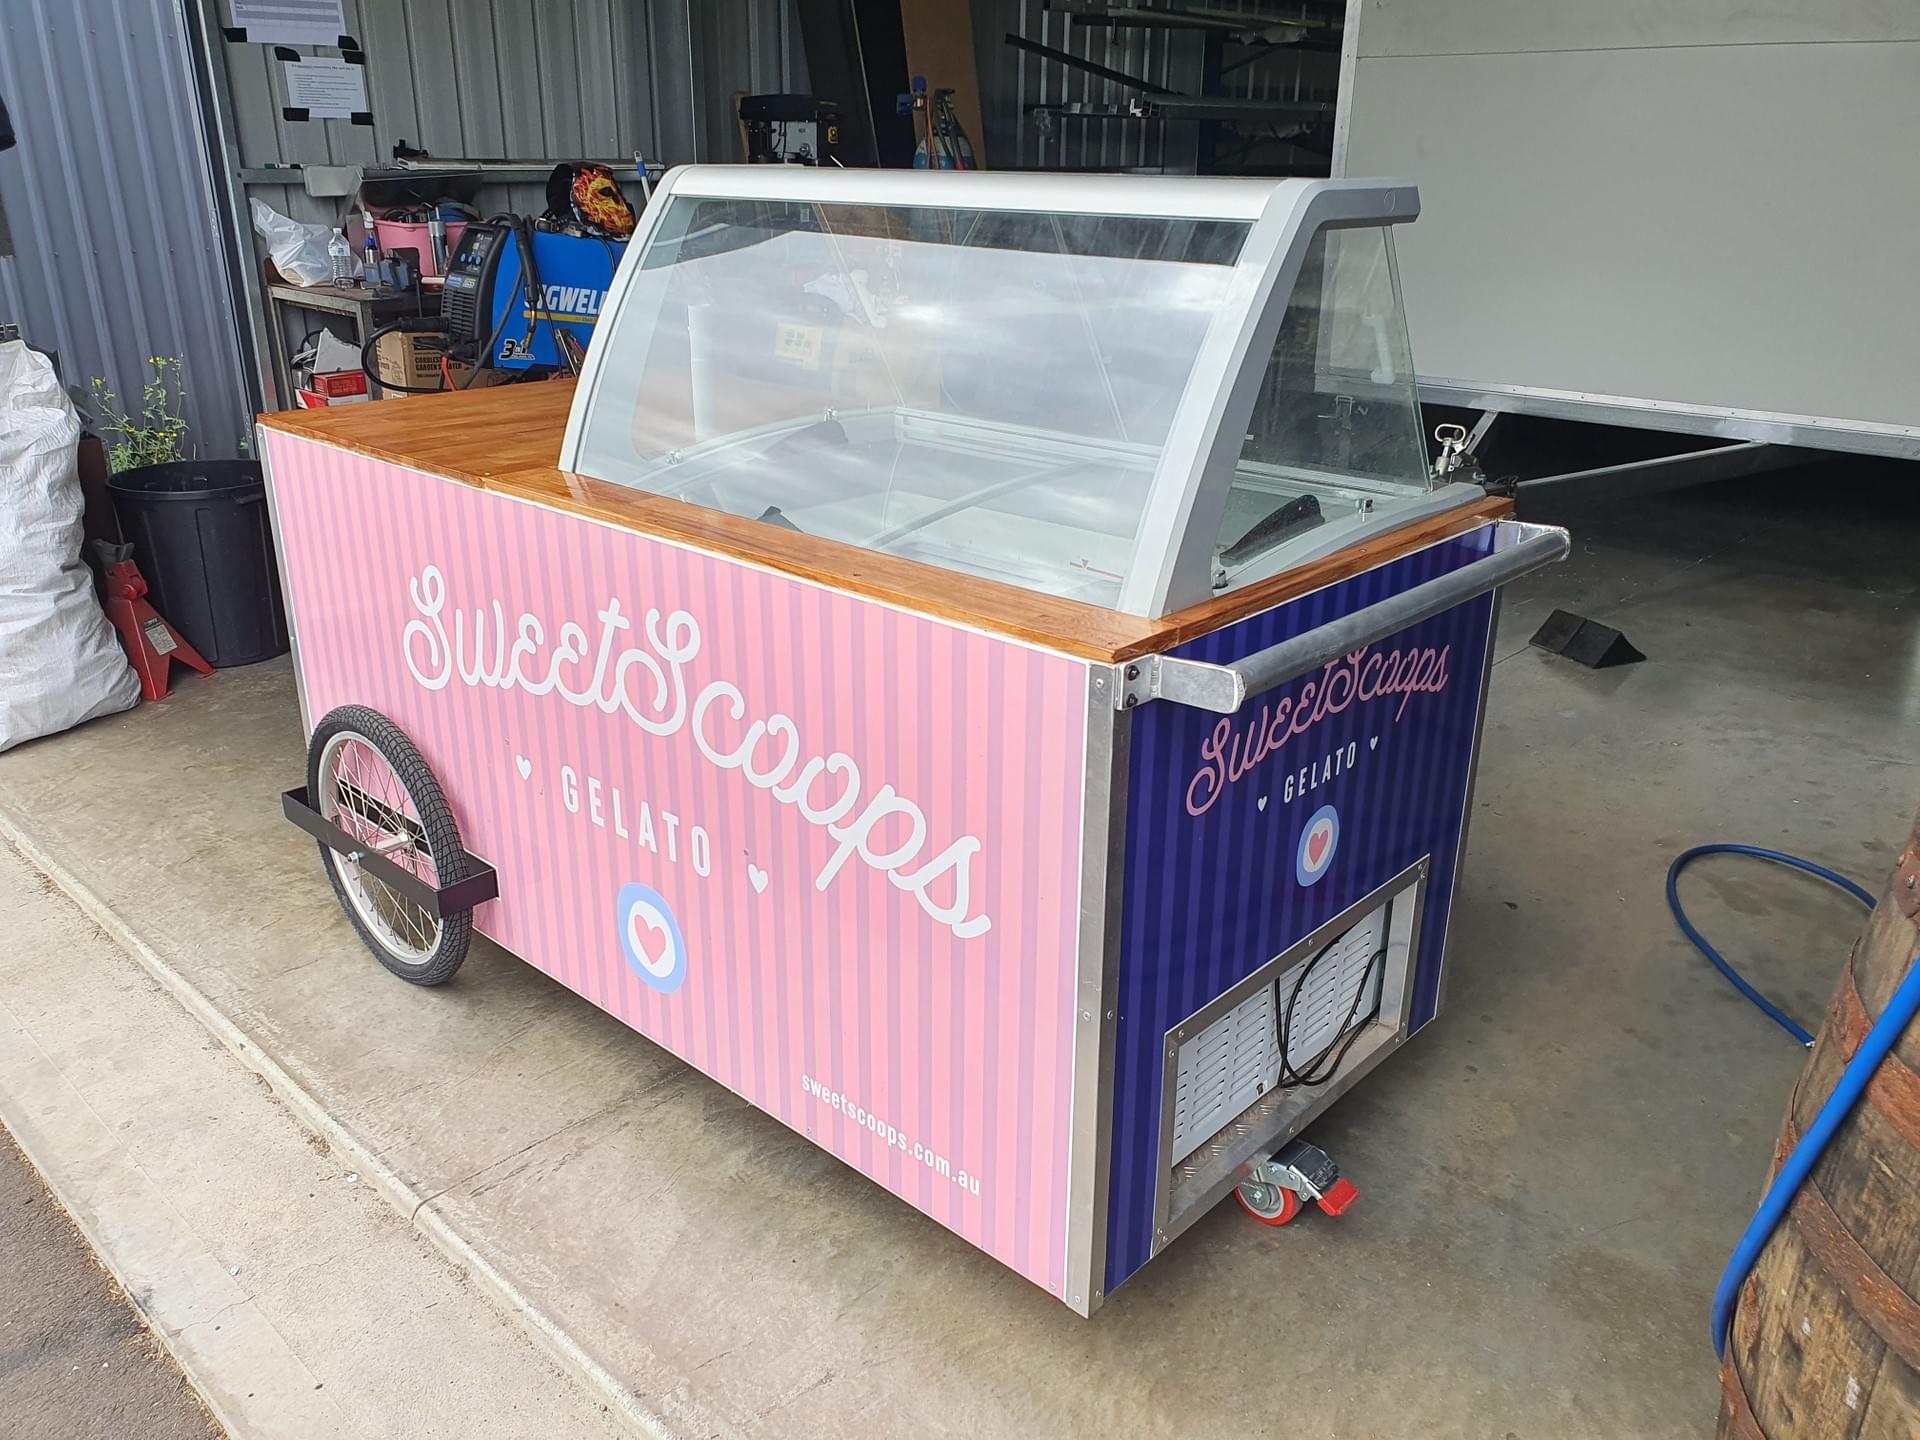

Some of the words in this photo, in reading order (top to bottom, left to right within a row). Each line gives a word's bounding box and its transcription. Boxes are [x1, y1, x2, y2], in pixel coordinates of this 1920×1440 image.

[524, 284, 608, 314] IGWEL
[1284, 741, 1357, 803] GELATO
[561, 765, 711, 877] GELATO
[801, 1073, 980, 1196] sweetscoops.com.au
